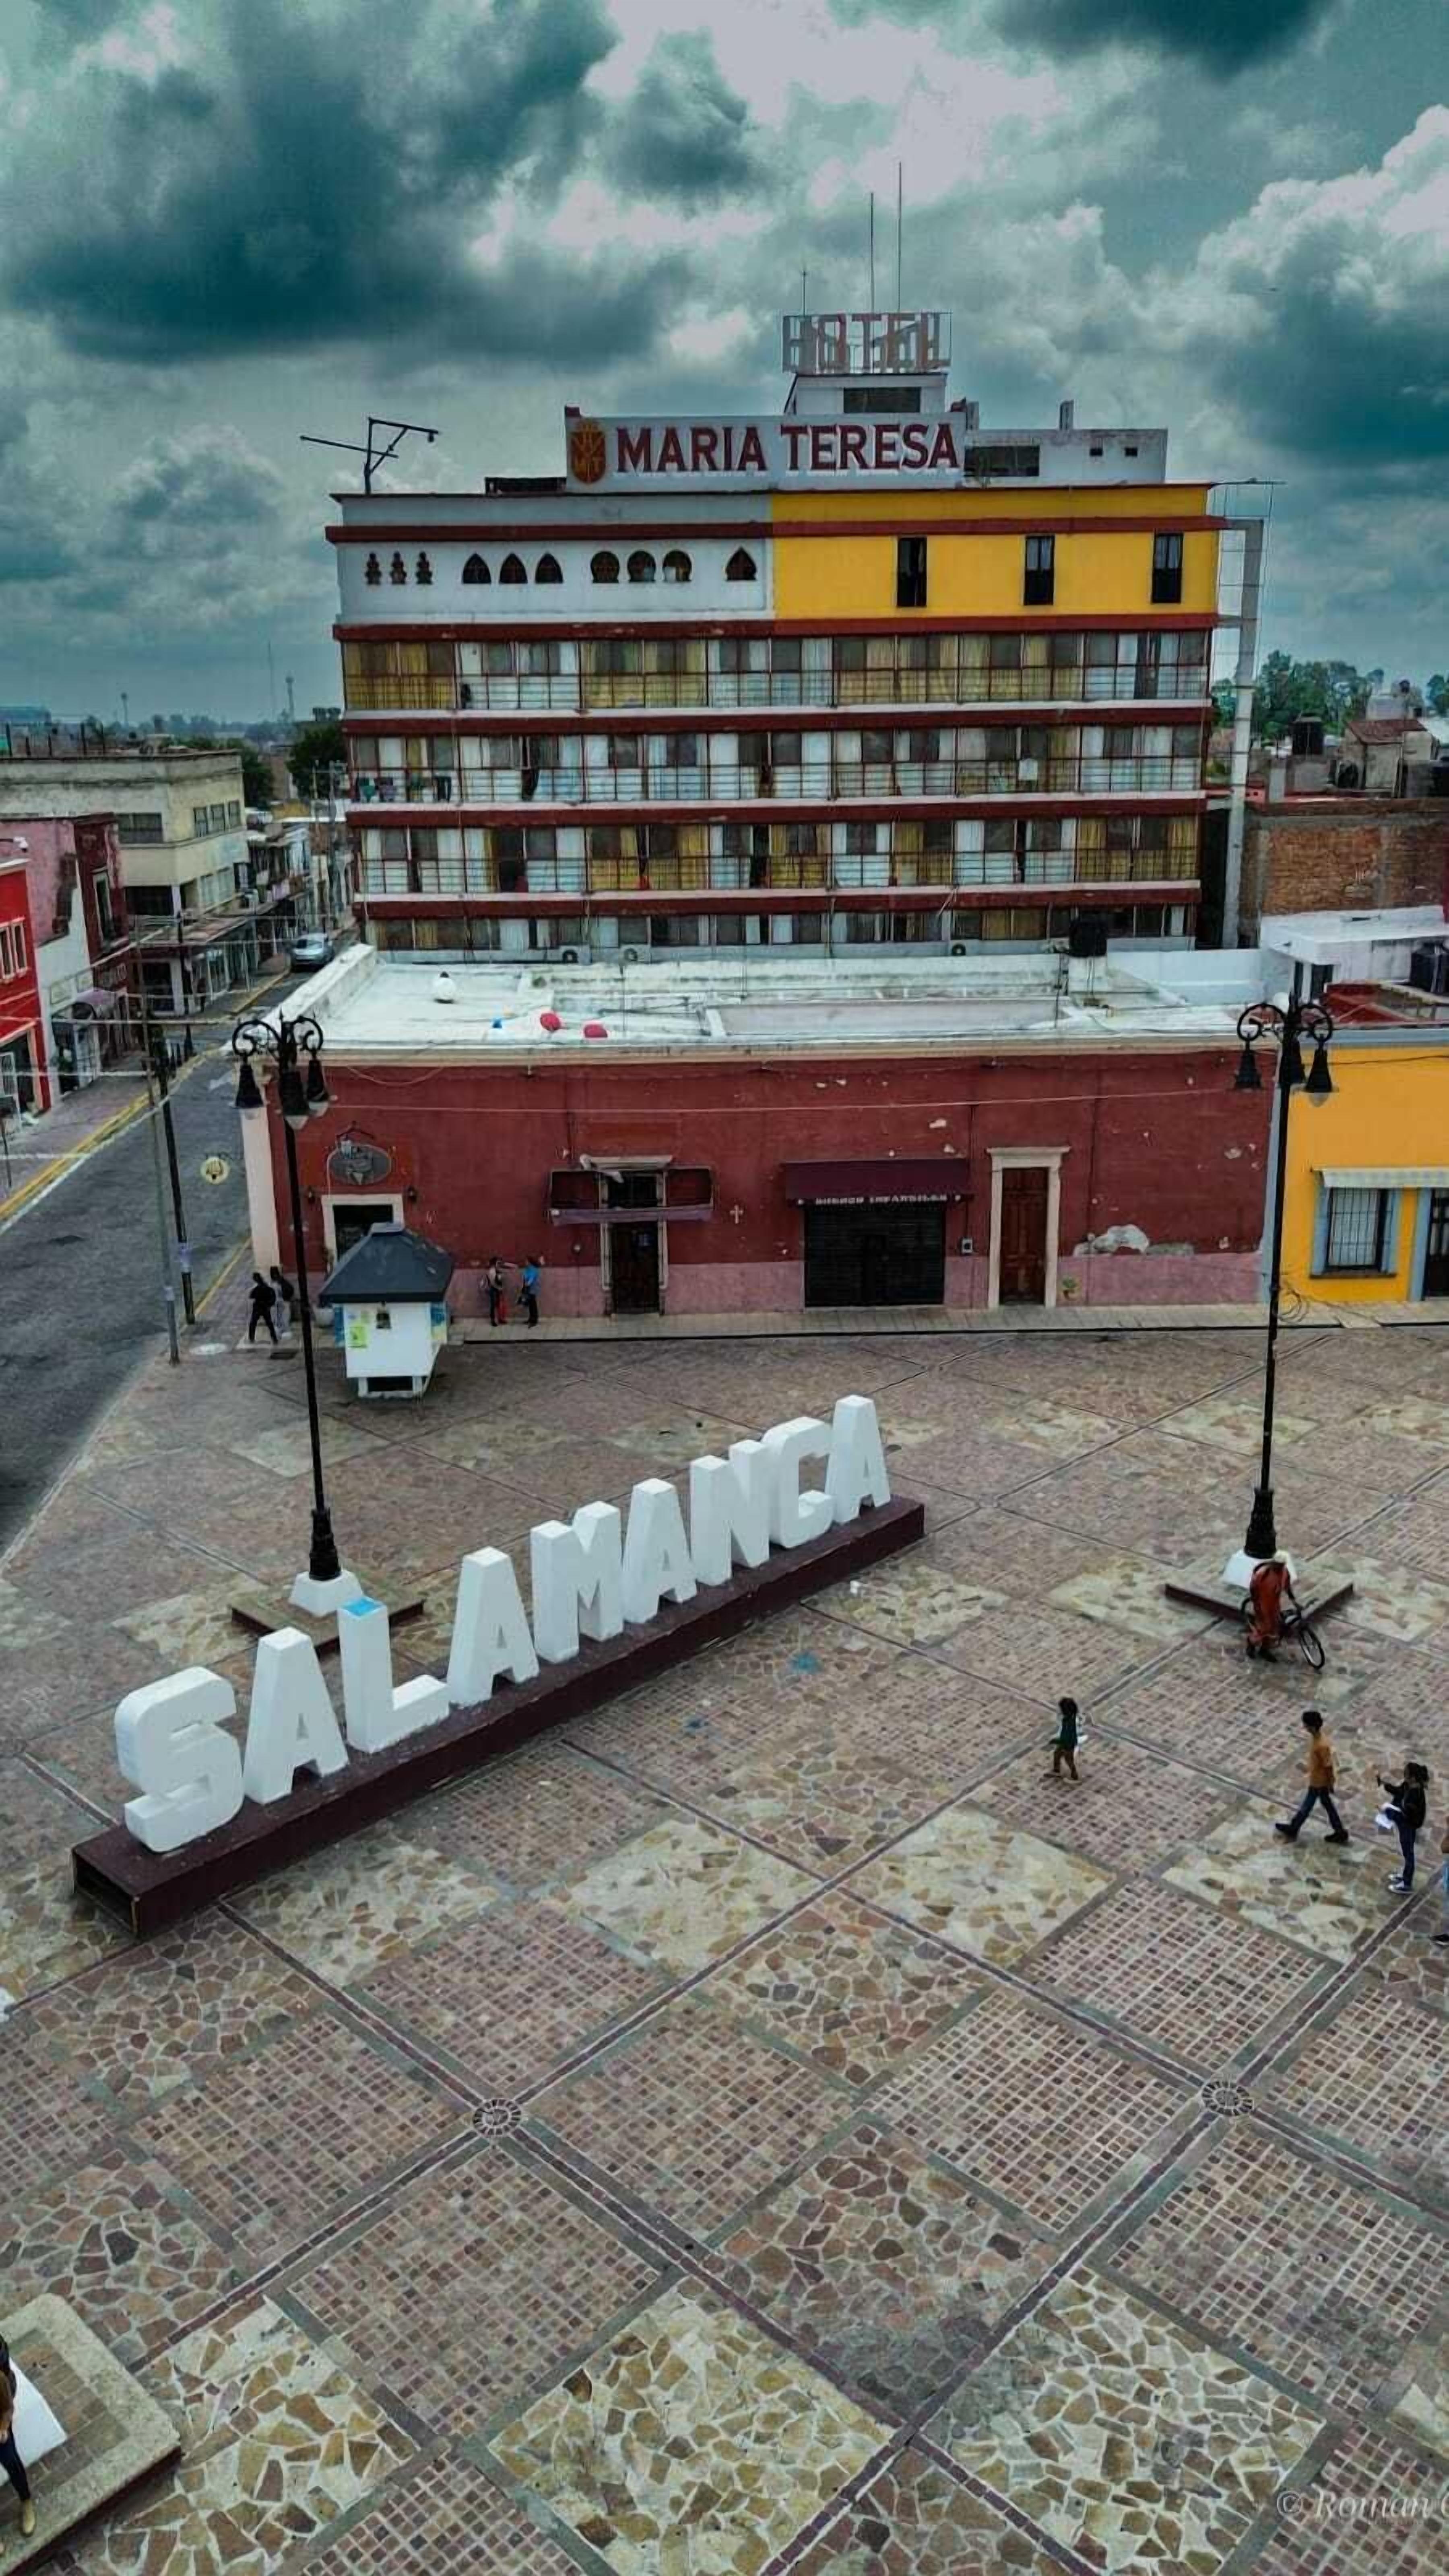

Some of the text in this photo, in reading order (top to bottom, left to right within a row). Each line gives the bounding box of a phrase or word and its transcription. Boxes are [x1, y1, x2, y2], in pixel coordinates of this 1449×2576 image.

[782, 313, 951, 372] HOTEL
[617, 423, 961, 473] MARIA TERESA
[115, 1394, 891, 1853] SALAMANCA
